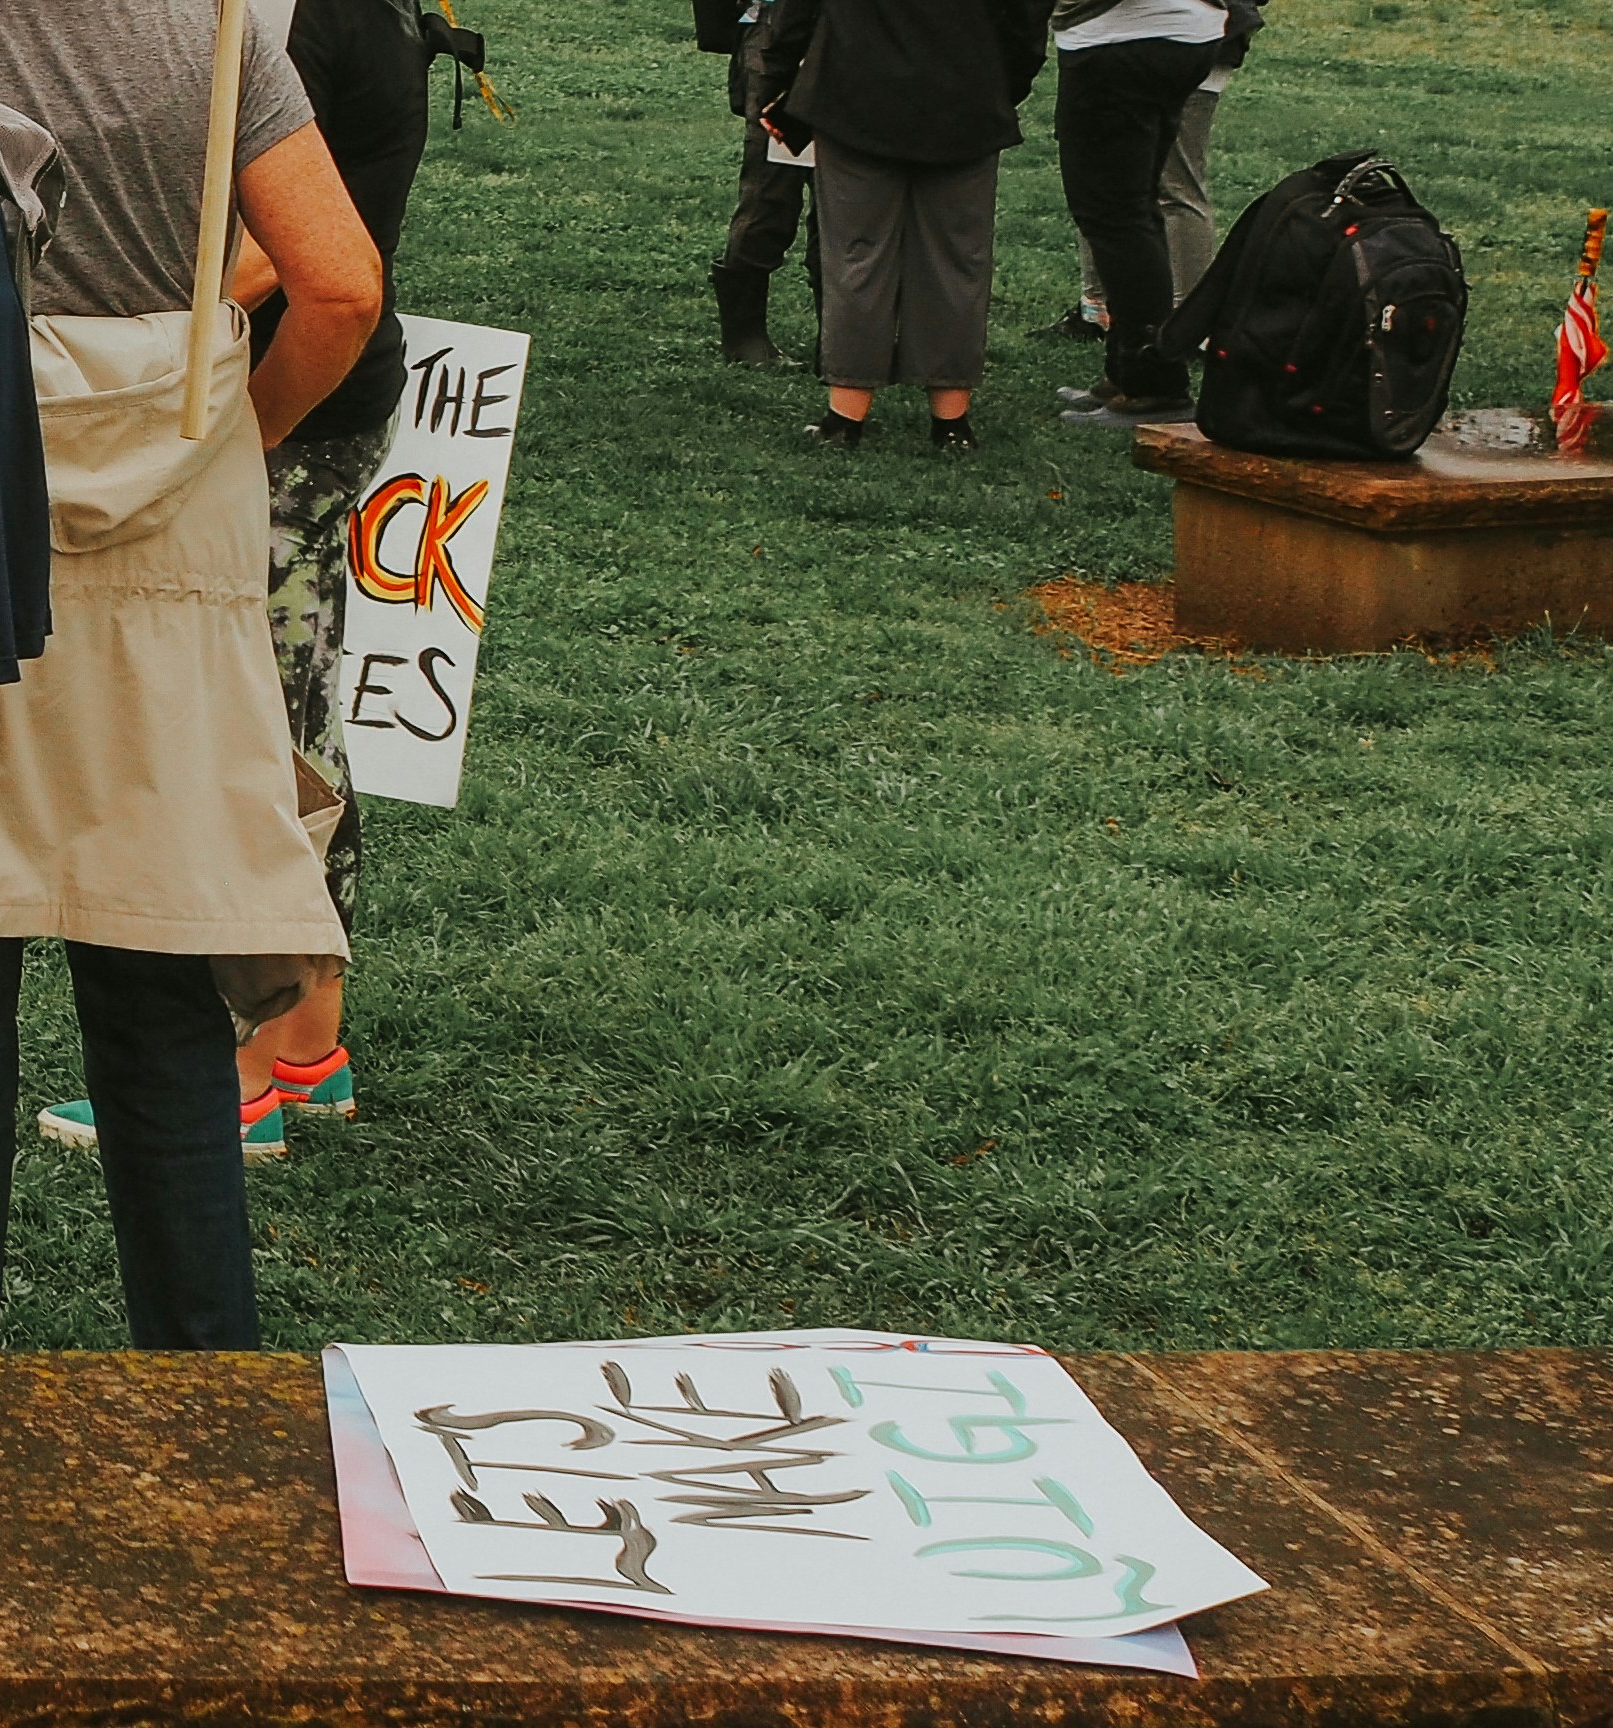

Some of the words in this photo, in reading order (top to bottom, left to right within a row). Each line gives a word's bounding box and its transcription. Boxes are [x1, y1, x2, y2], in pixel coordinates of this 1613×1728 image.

[411, 347, 518, 438] THE
[594, 1360, 875, 1542] MAKE
[828, 1364, 1177, 1623] LUIGI
